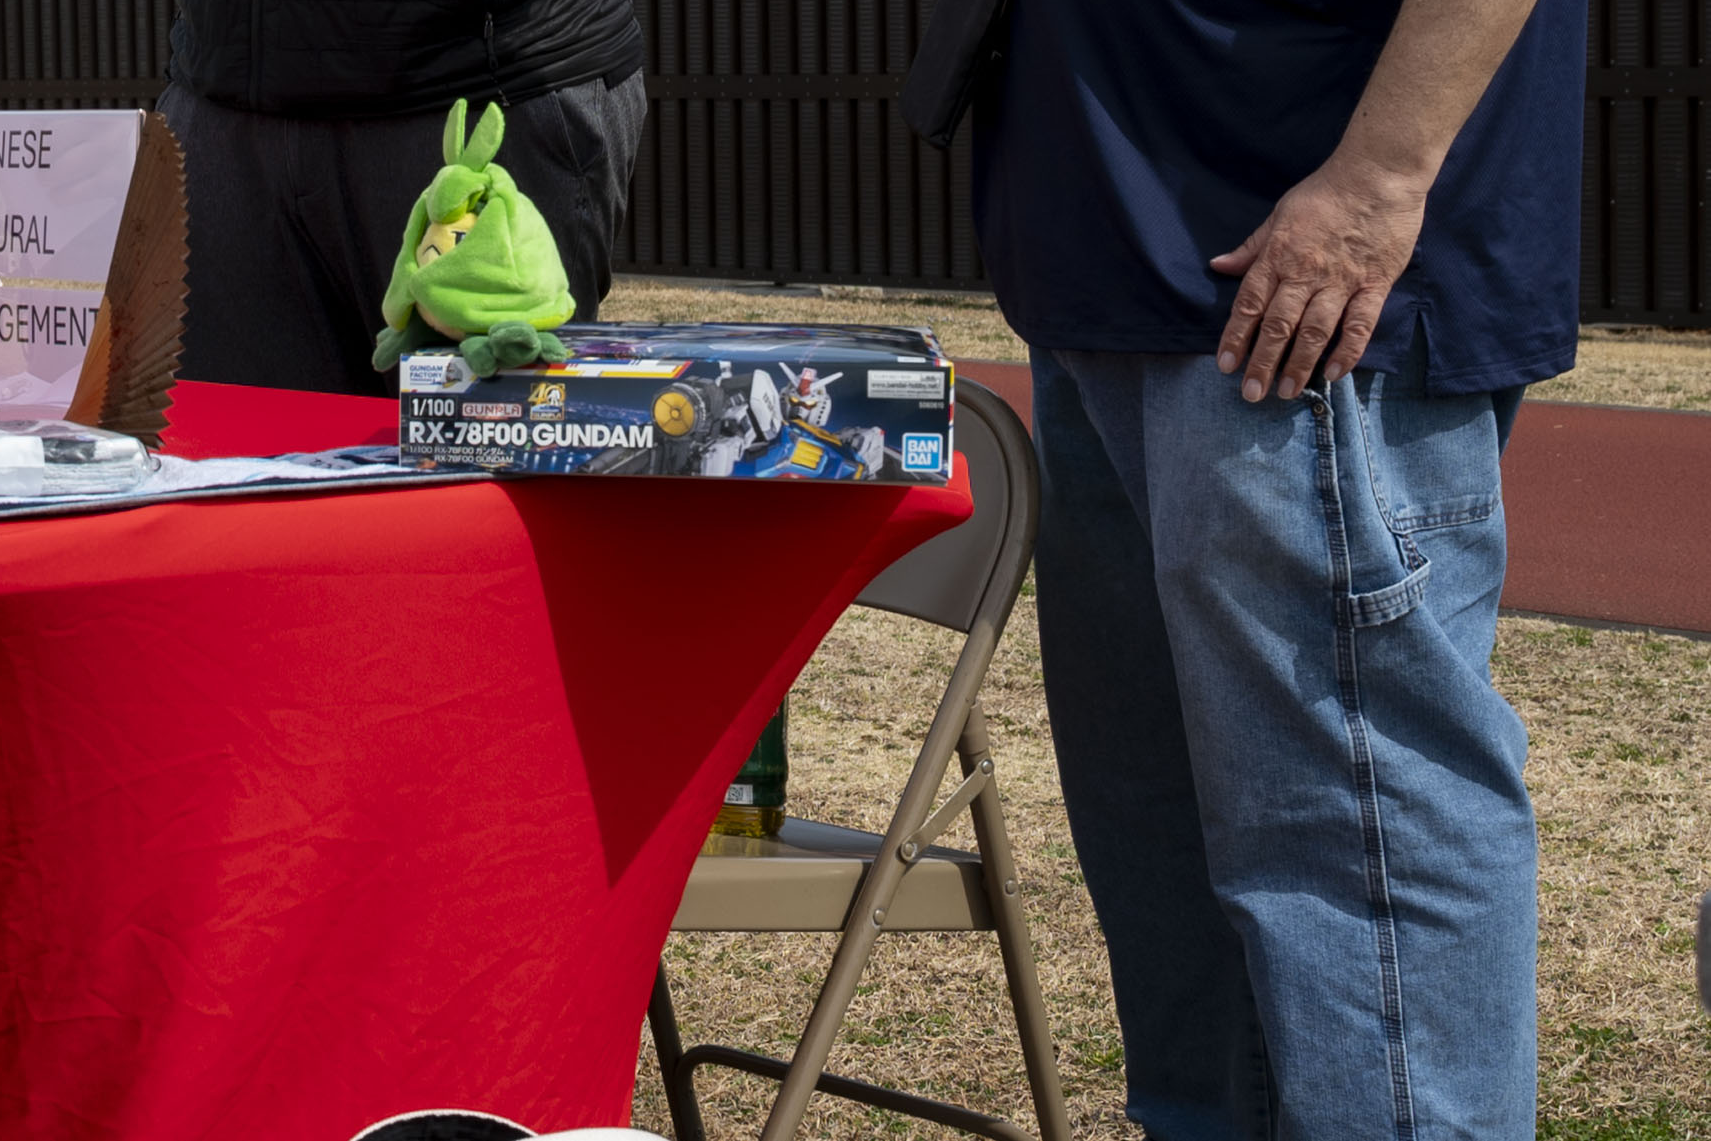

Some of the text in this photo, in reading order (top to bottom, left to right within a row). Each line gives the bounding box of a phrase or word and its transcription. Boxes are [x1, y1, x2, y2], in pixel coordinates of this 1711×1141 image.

[410, 364, 443, 372] GUNDAM
[411, 398, 521, 417] 1/100 GUNPLA
[409, 421, 654, 448] RX-78F00 GUNDAM
[907, 439, 938, 453] BAN
[907, 452, 932, 466] DAI
